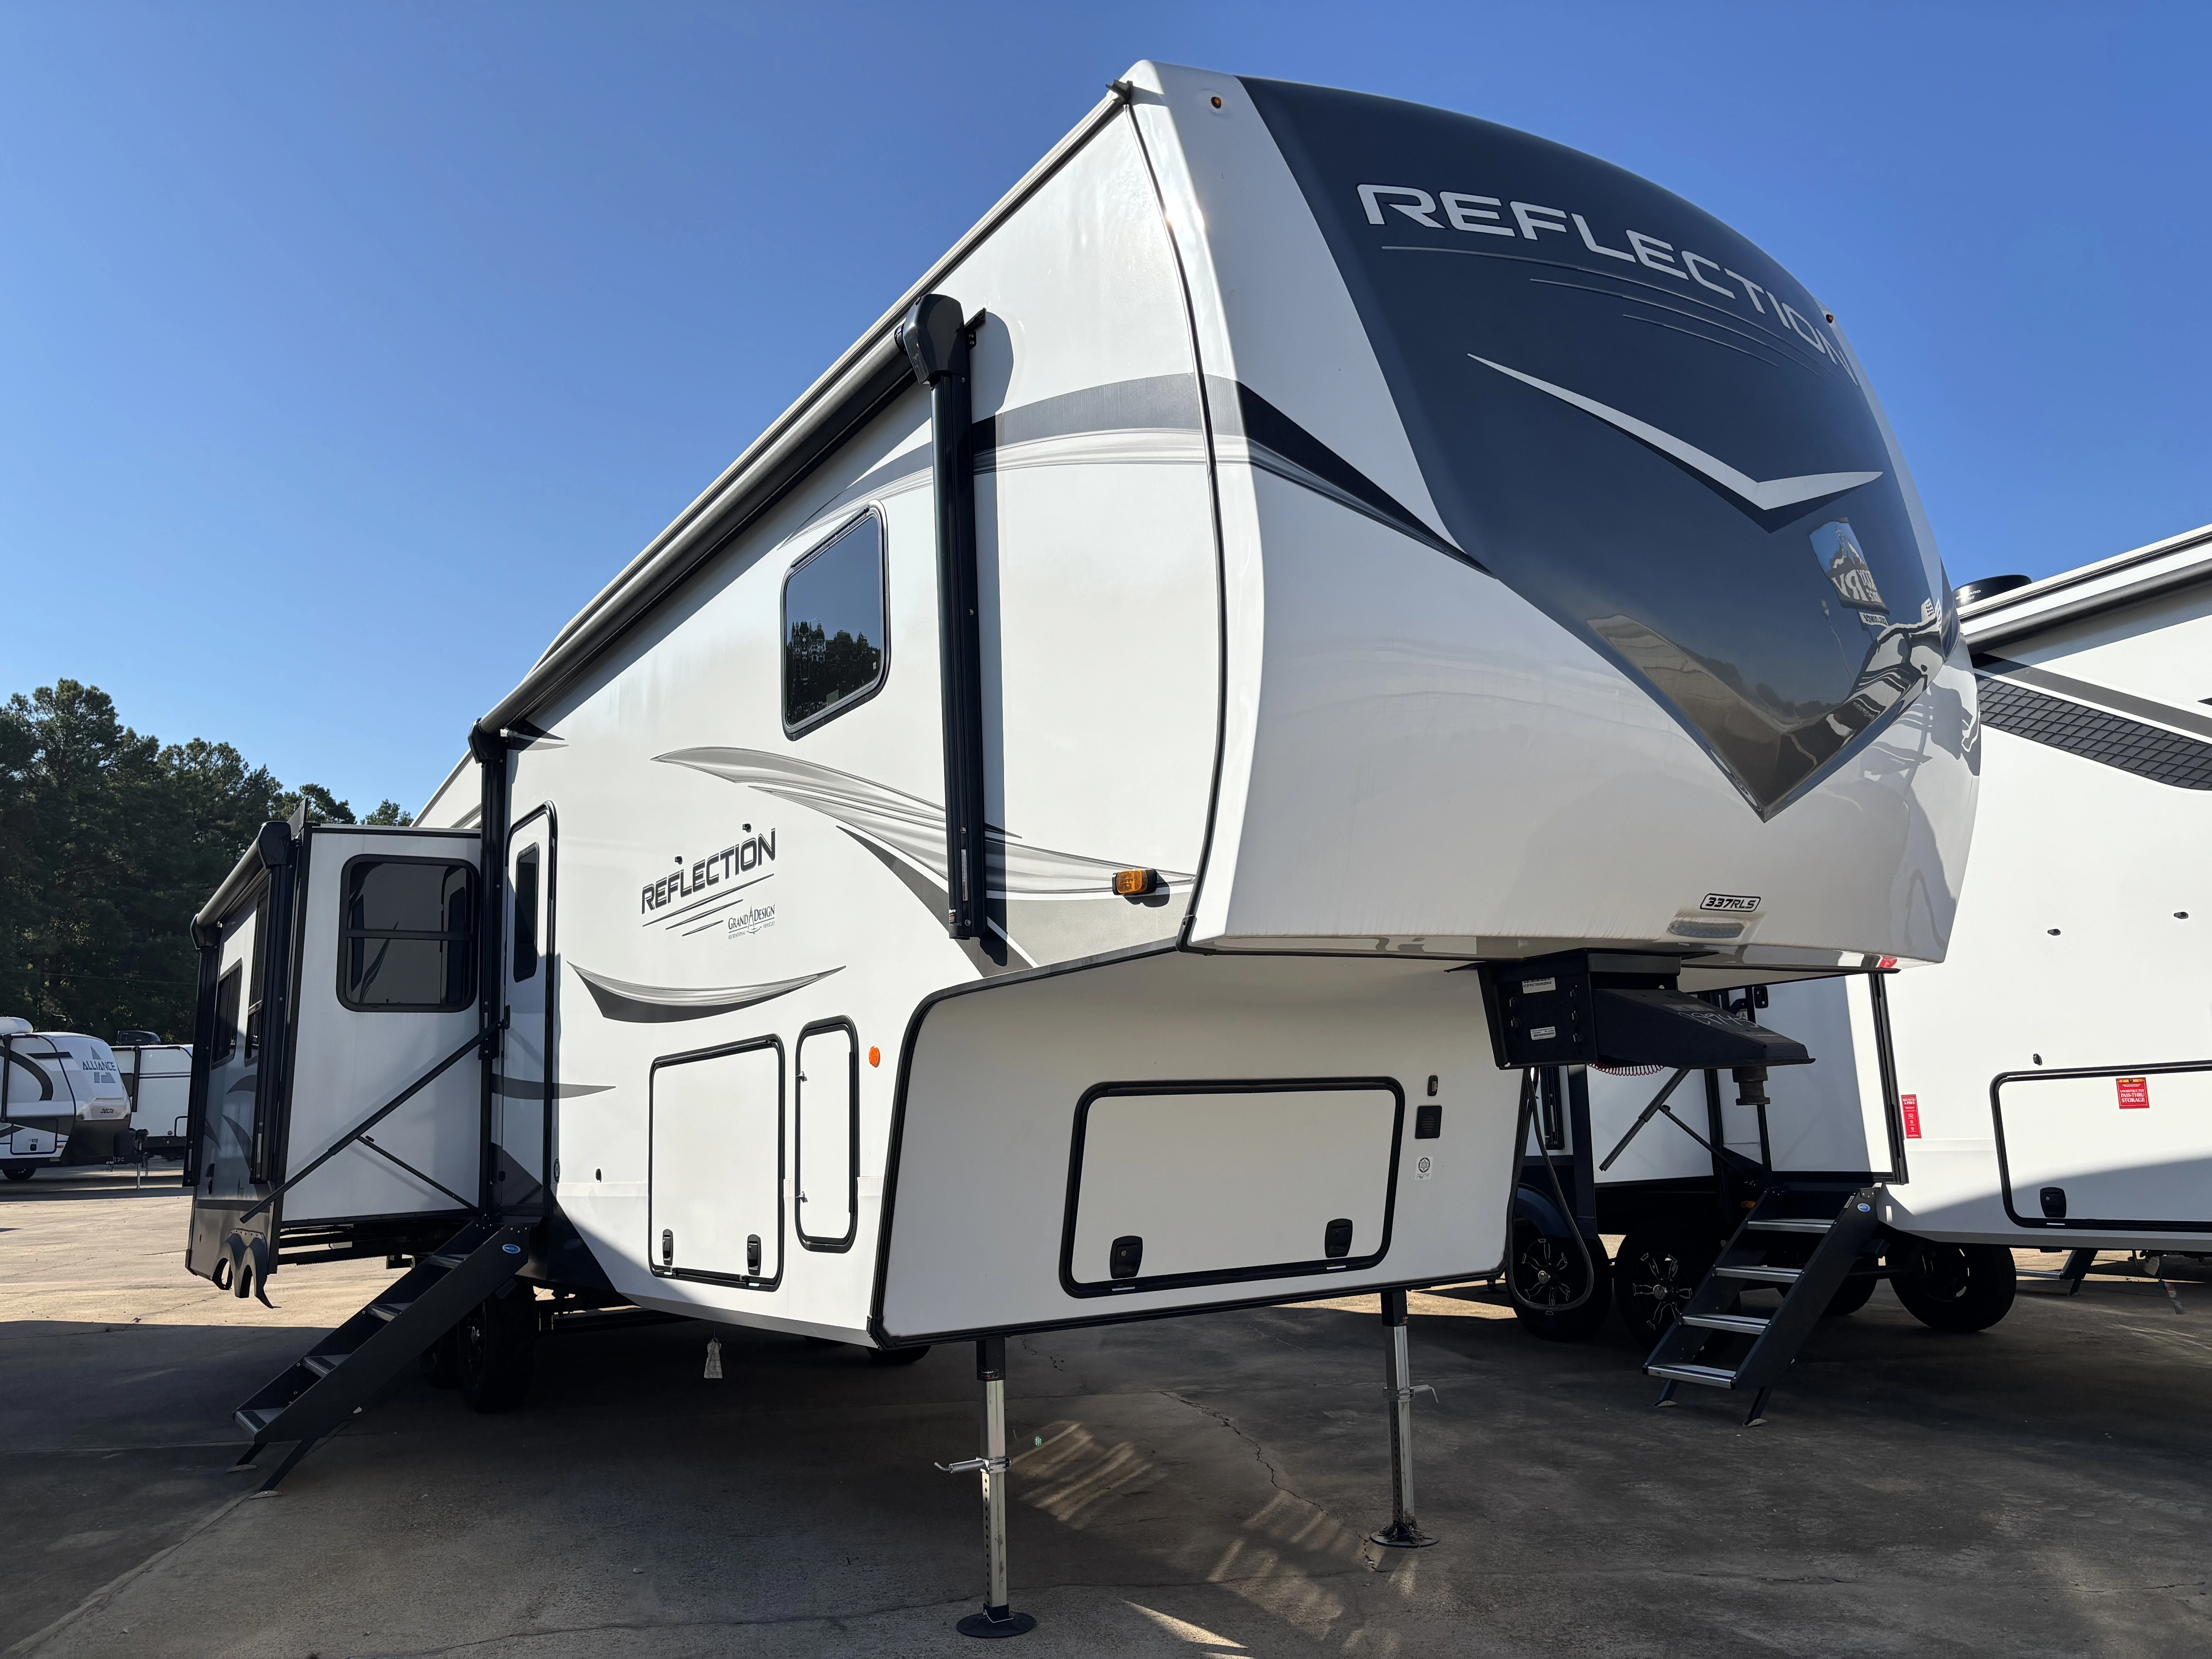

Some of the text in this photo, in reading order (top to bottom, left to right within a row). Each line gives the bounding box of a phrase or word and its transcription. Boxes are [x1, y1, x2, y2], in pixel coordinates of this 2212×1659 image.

[1357, 183, 1859, 386] REFLECTION
[642, 827, 775, 914] REFLECTION
[1705, 896, 1756, 908] 337RLS
[728, 904, 775, 929] GRAND DESIGN
[82, 1061, 117, 1071] ALLIANCE
